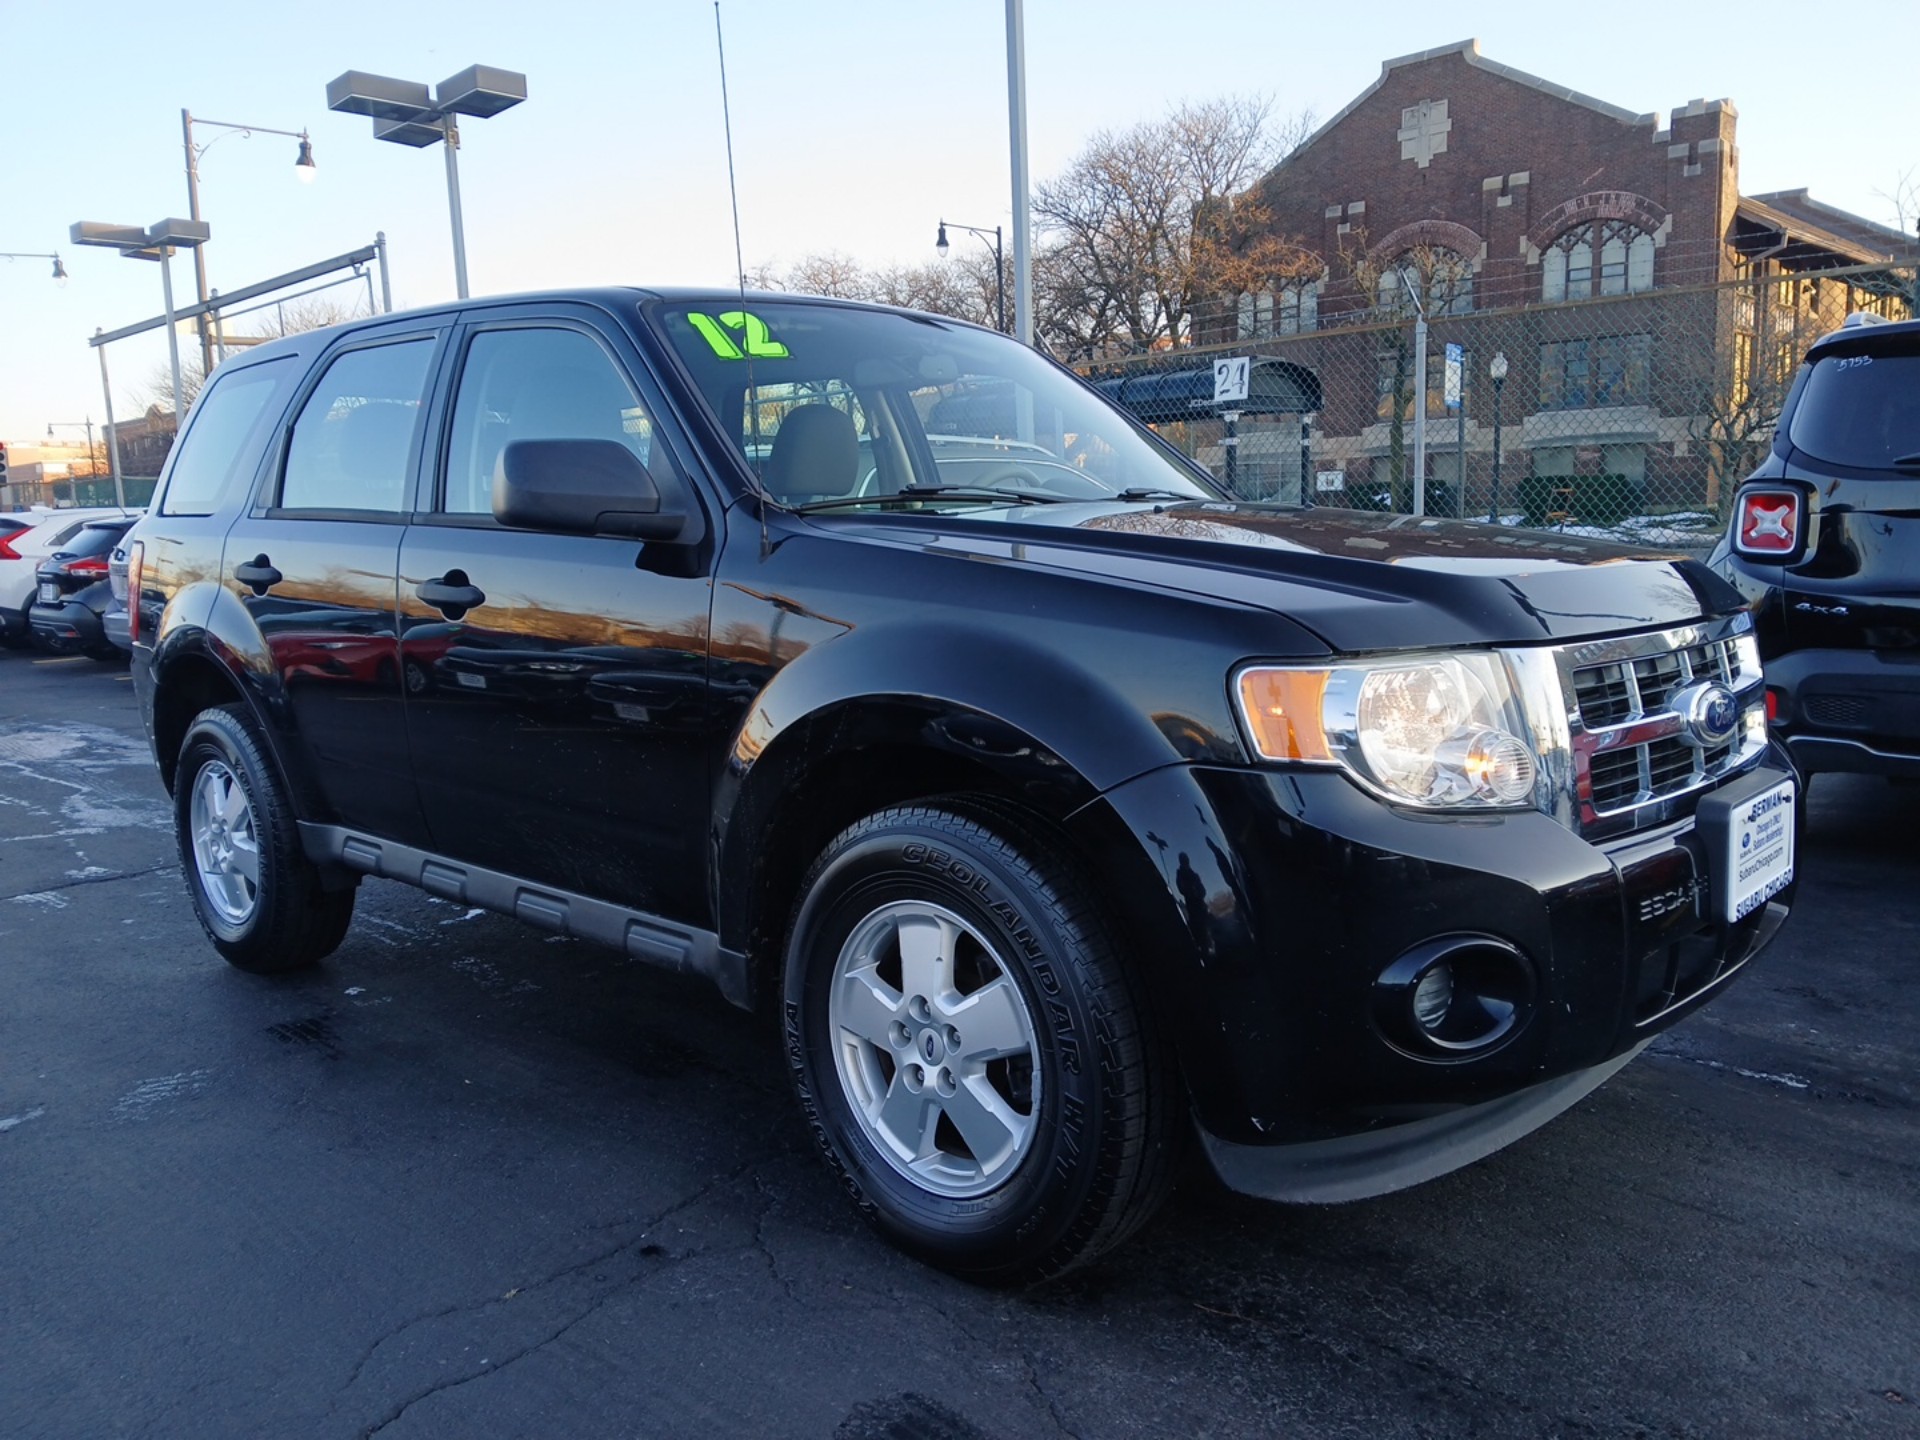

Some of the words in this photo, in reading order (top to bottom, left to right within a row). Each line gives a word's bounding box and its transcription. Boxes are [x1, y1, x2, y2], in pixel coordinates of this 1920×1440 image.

[687, 311, 789, 358] 12
[1218, 362, 1246, 396] 24
[1837, 355, 1873, 371] 5753
[1795, 602, 1849, 615] 4x4
[1751, 790, 1782, 818] BERMAN
[1736, 888, 1764, 920] SUBARU
[1764, 868, 1793, 900] CHICAGO
[902, 842, 1081, 1075] GEOLANDAR
